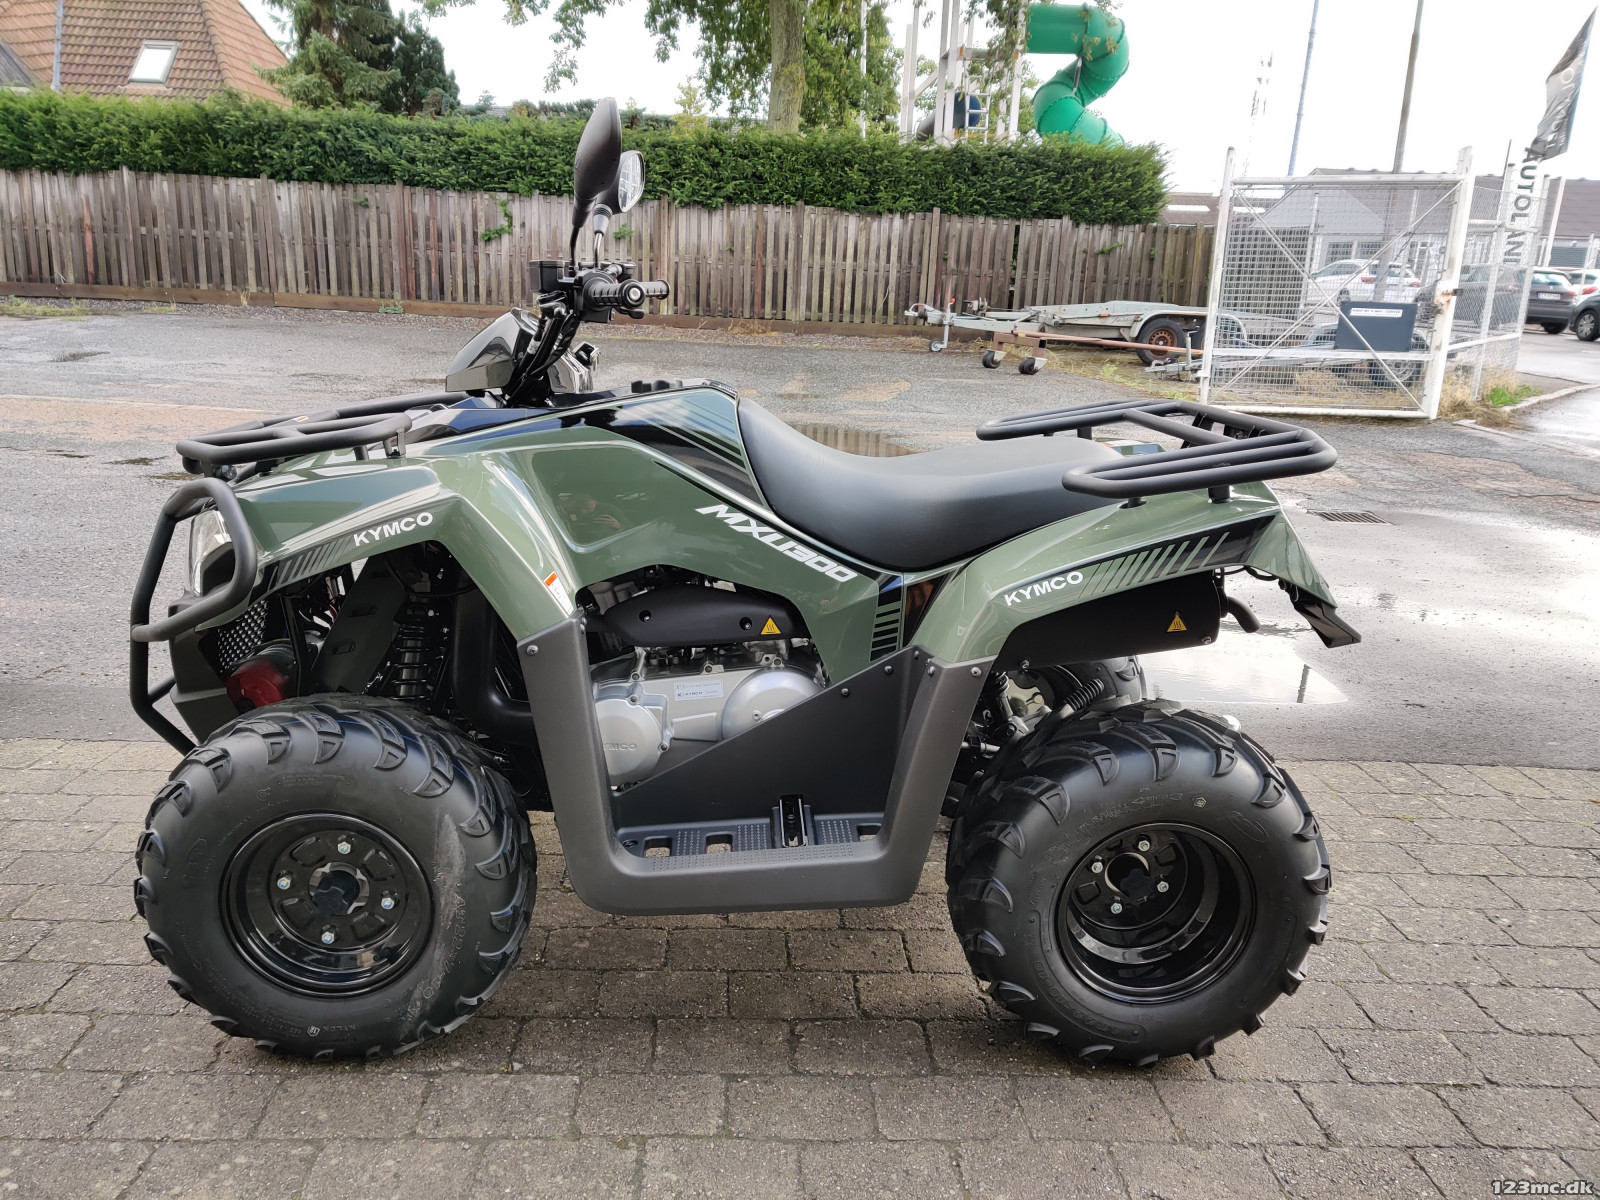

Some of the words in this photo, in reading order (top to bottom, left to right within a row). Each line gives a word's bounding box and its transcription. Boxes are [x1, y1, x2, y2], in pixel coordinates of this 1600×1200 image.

[353, 511, 434, 547] KYMCO
[695, 503, 858, 583] MXU300
[1004, 571, 1084, 607] KYMCO
